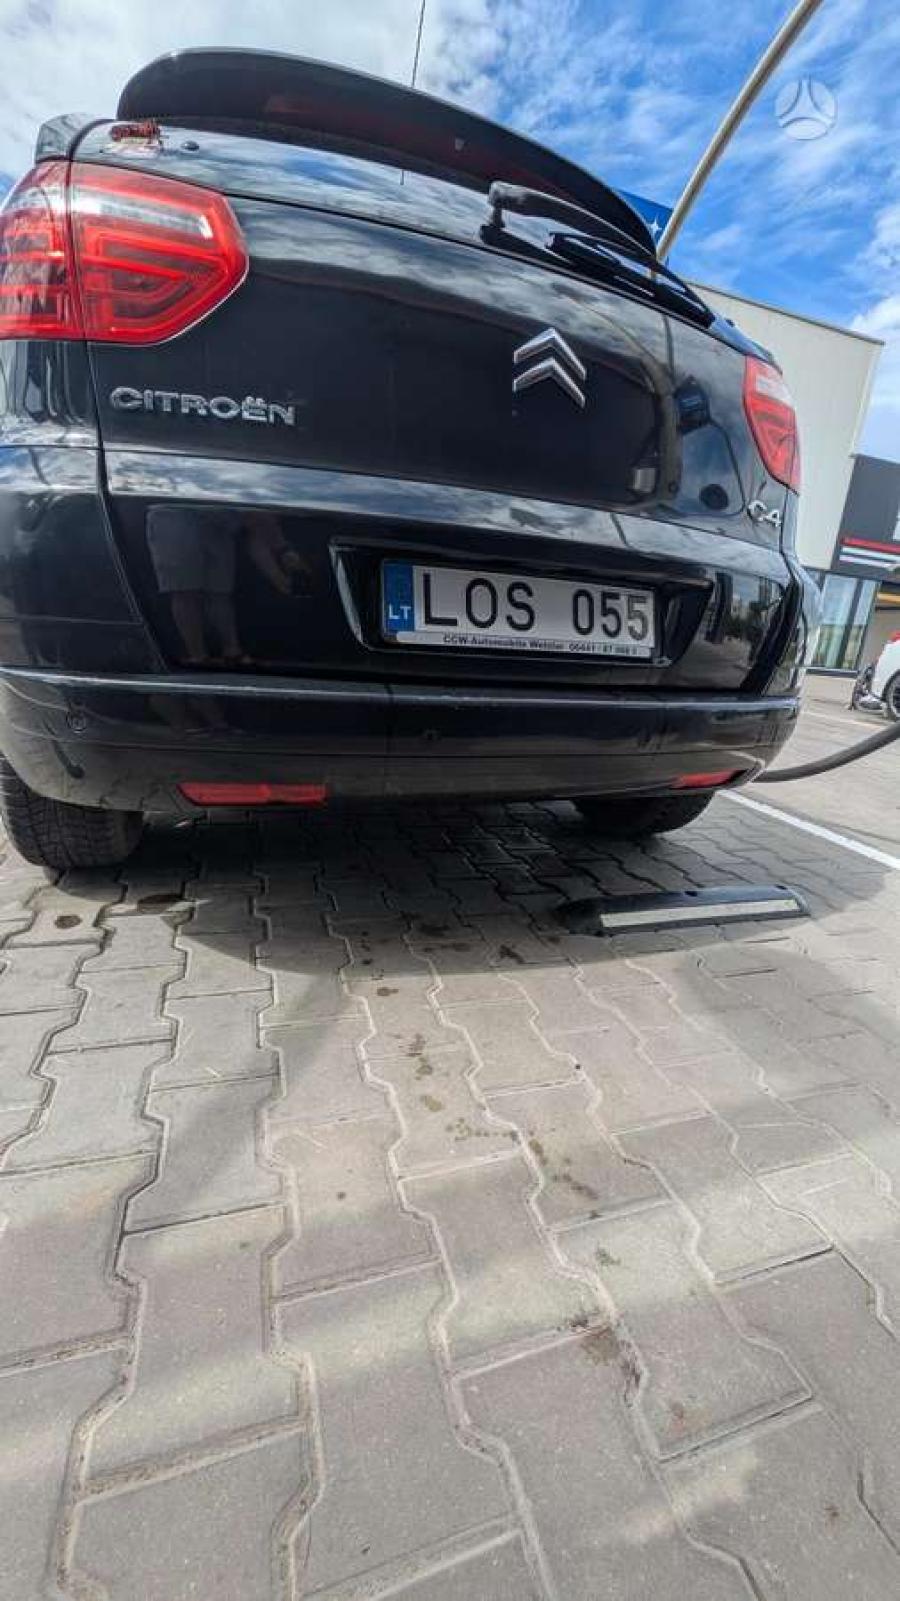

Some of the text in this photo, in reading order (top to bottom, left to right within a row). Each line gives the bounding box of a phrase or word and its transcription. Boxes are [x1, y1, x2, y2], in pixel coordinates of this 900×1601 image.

[110, 386, 295, 426] CITROËN
[748, 500, 781, 527] C4
[388, 604, 411, 620] LT
[422, 572, 648, 641] LOS 055
